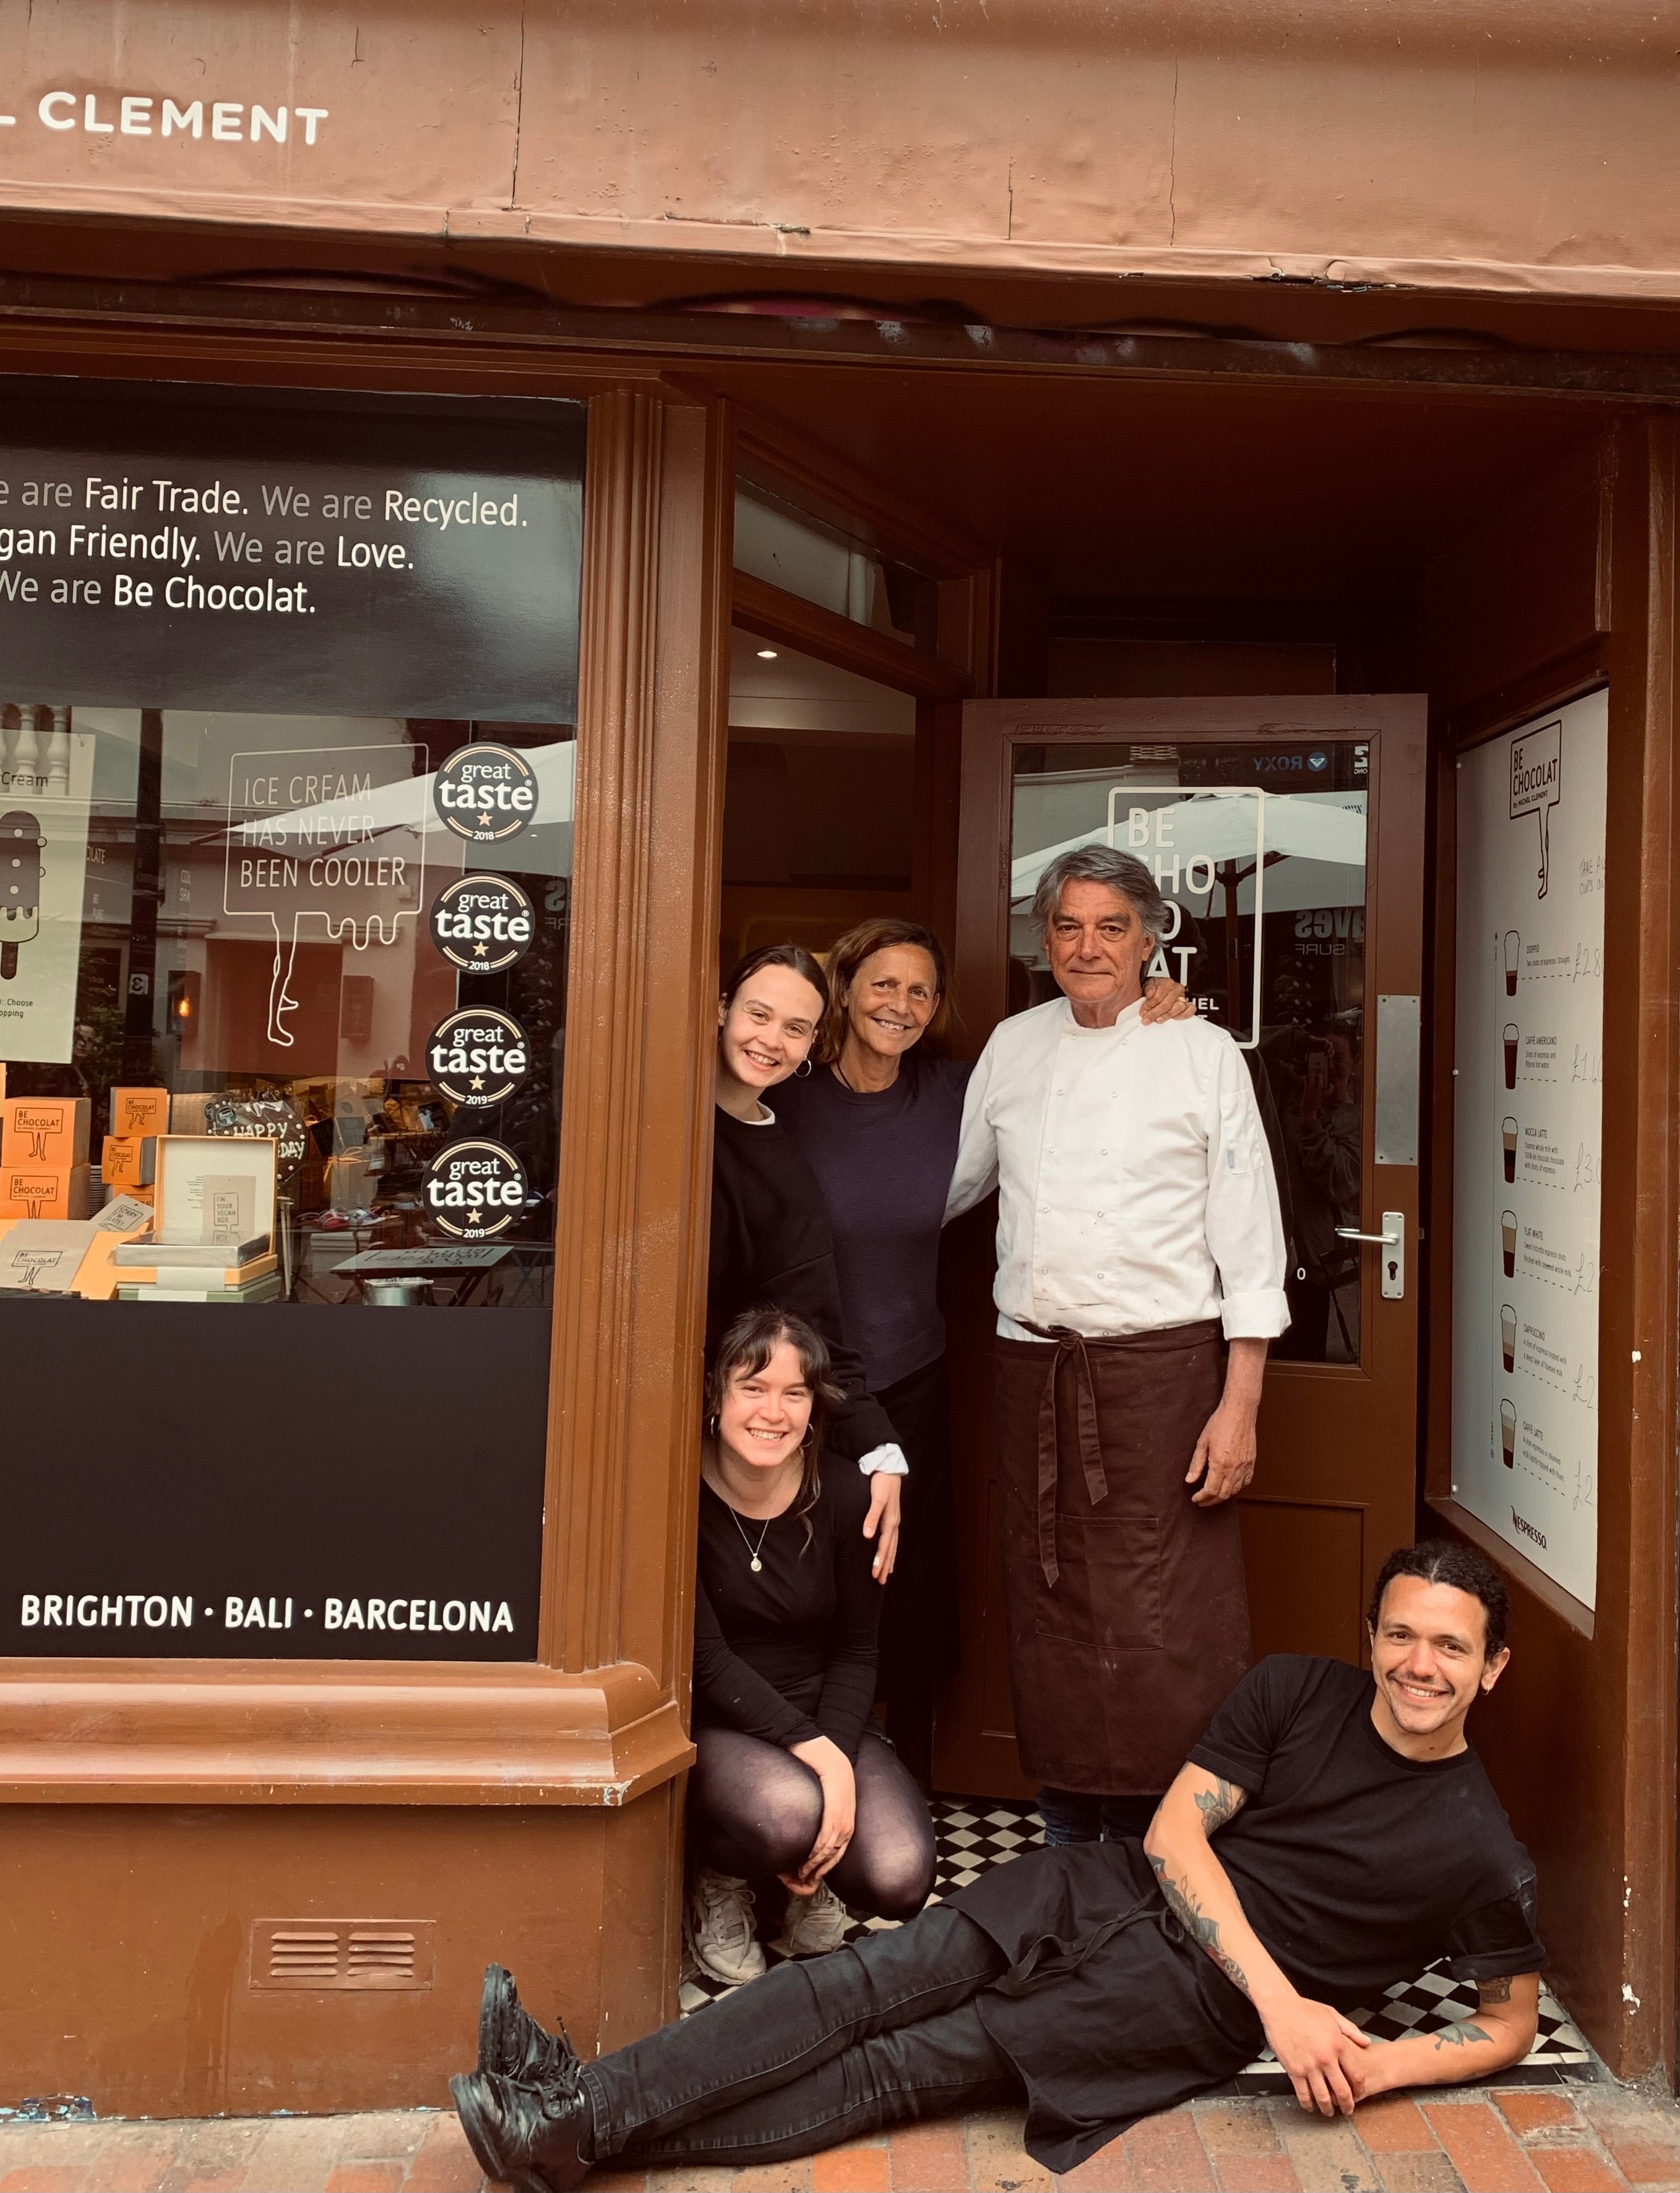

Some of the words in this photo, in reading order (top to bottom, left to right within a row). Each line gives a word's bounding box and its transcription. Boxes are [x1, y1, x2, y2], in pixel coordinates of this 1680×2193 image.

[39, 92, 329, 145] CLEMENT
[0, 480, 9, 504] e
[22, 482, 72, 507] are
[86, 478, 144, 511] Fair
[152, 480, 249, 516] Trade.
[262, 485, 311, 518] We
[322, 491, 372, 520] are
[385, 491, 527, 530] Recycled.
[0, 528, 56, 561] gan
[70, 525, 201, 568] Friendly.
[214, 530, 263, 562] We
[275, 537, 325, 566] are
[337, 536, 415, 569] Love.
[0, 570, 38, 602] We
[51, 579, 101, 606] are
[114, 575, 153, 608] Be
[165, 577, 316, 614] Chocolat.
[462, 762, 512, 782] great
[1514, 748, 1523, 772] BE
[1, 772, 48, 787] Cream
[244, 778, 278, 806] ICE
[289, 773, 371, 804] CREAM
[1513, 758, 1557, 796] CHOCOLAT
[438, 781, 533, 811] taste
[242, 818, 287, 847] HAS
[298, 815, 375, 845] NEVER
[473, 830, 494, 840] 2018
[1128, 808, 1175, 847] BE
[241, 859, 298, 887] BEEN
[309, 856, 405, 886] COOLER
[1135, 854, 1215, 895] HO
[458, 892, 508, 912] great
[434, 908, 530, 941] taste
[468, 960, 490, 971] 2018
[1147, 947, 1197, 988] AT
[0, 1010, 24, 1019] opping
[453, 1025, 504, 1047] great
[429, 1046, 526, 1074] taste
[465, 1095, 488, 1105] 2019
[233, 1122, 288, 1139] HAPPY
[449, 1157, 501, 1179] great
[14, 1186, 54, 1194] CHOCOLAT
[426, 1178, 523, 1207] taste
[119, 1207, 139, 1218] SORRY
[463, 1228, 485, 1238] 2019
[1510, 1505, 1547, 1549] NESPRESSO
[21, 1595, 193, 1628] BRIGHTON
[225, 1596, 292, 1629] BALI
[325, 1598, 514, 1632] BARCELONA
